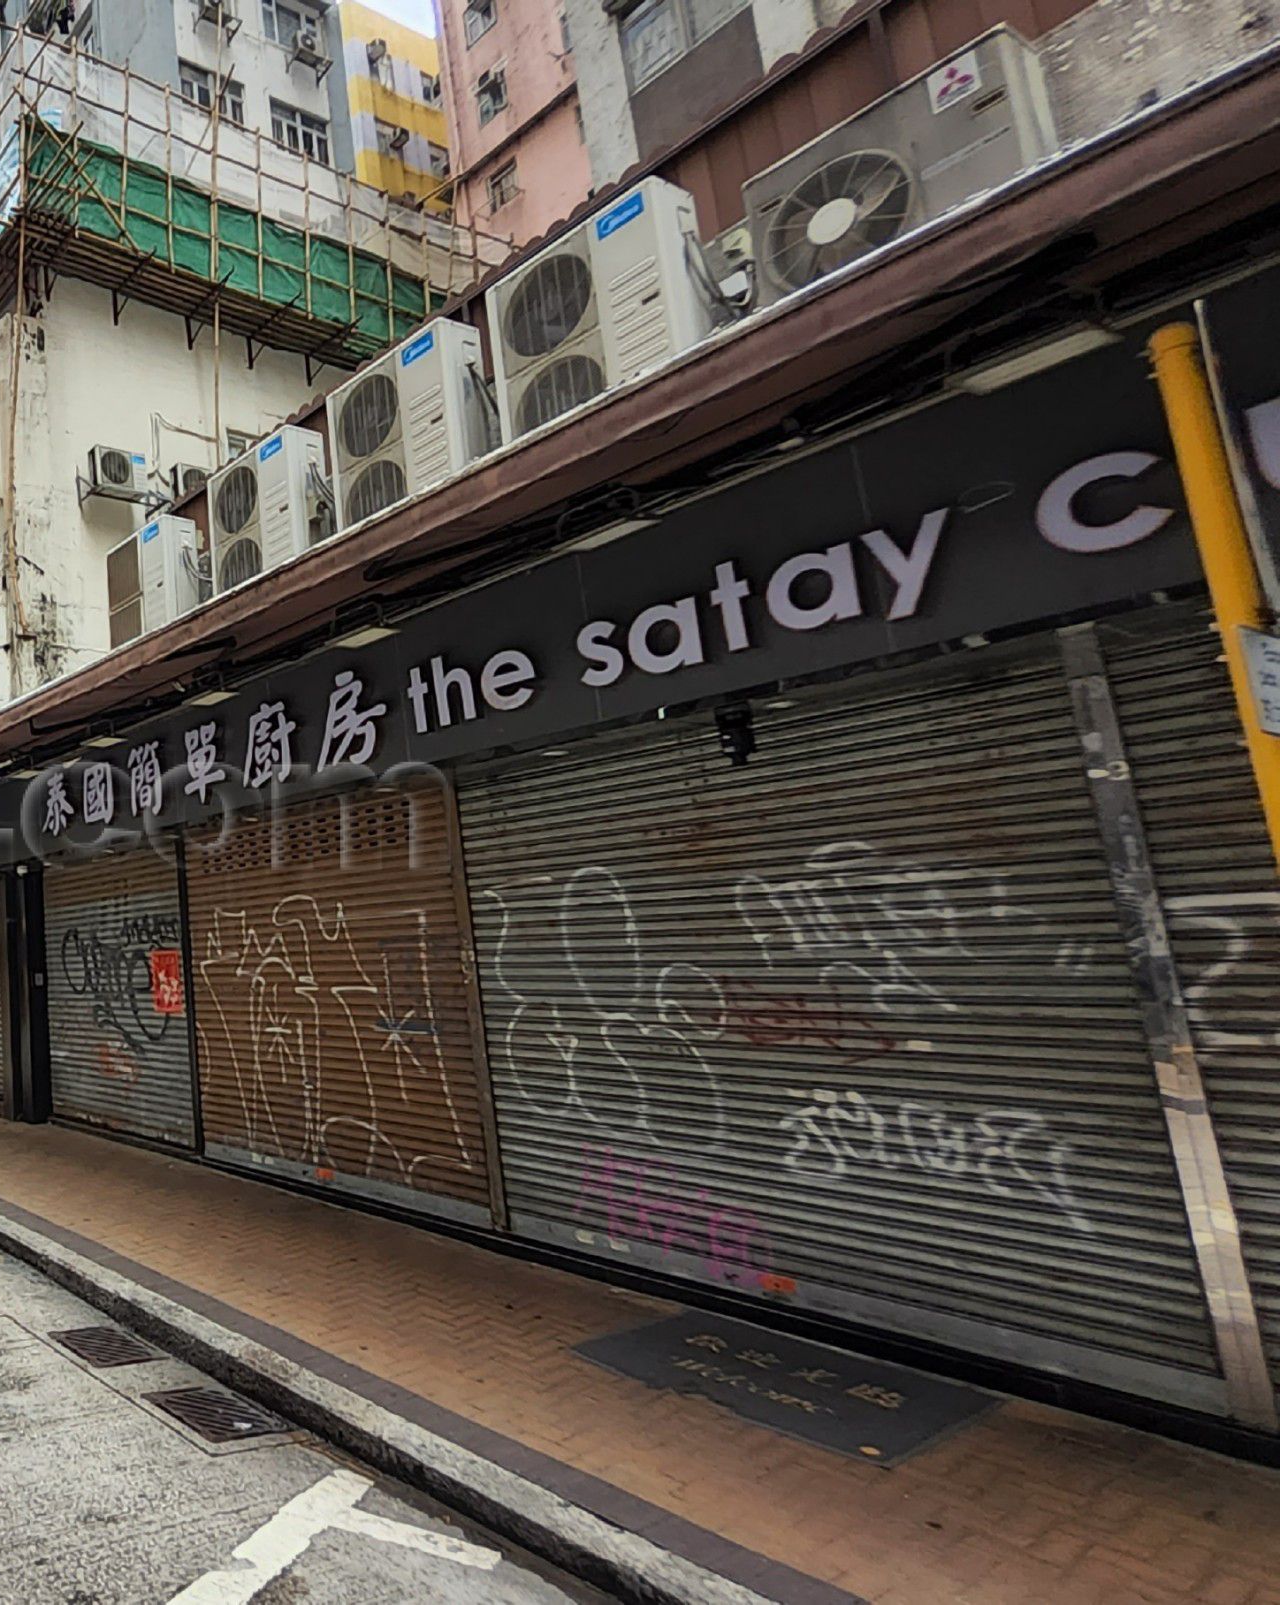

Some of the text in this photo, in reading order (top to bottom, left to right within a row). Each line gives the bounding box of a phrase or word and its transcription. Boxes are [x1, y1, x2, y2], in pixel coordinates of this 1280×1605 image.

[41, 507, 951, 836] 泰國簡單廚房 the satay
